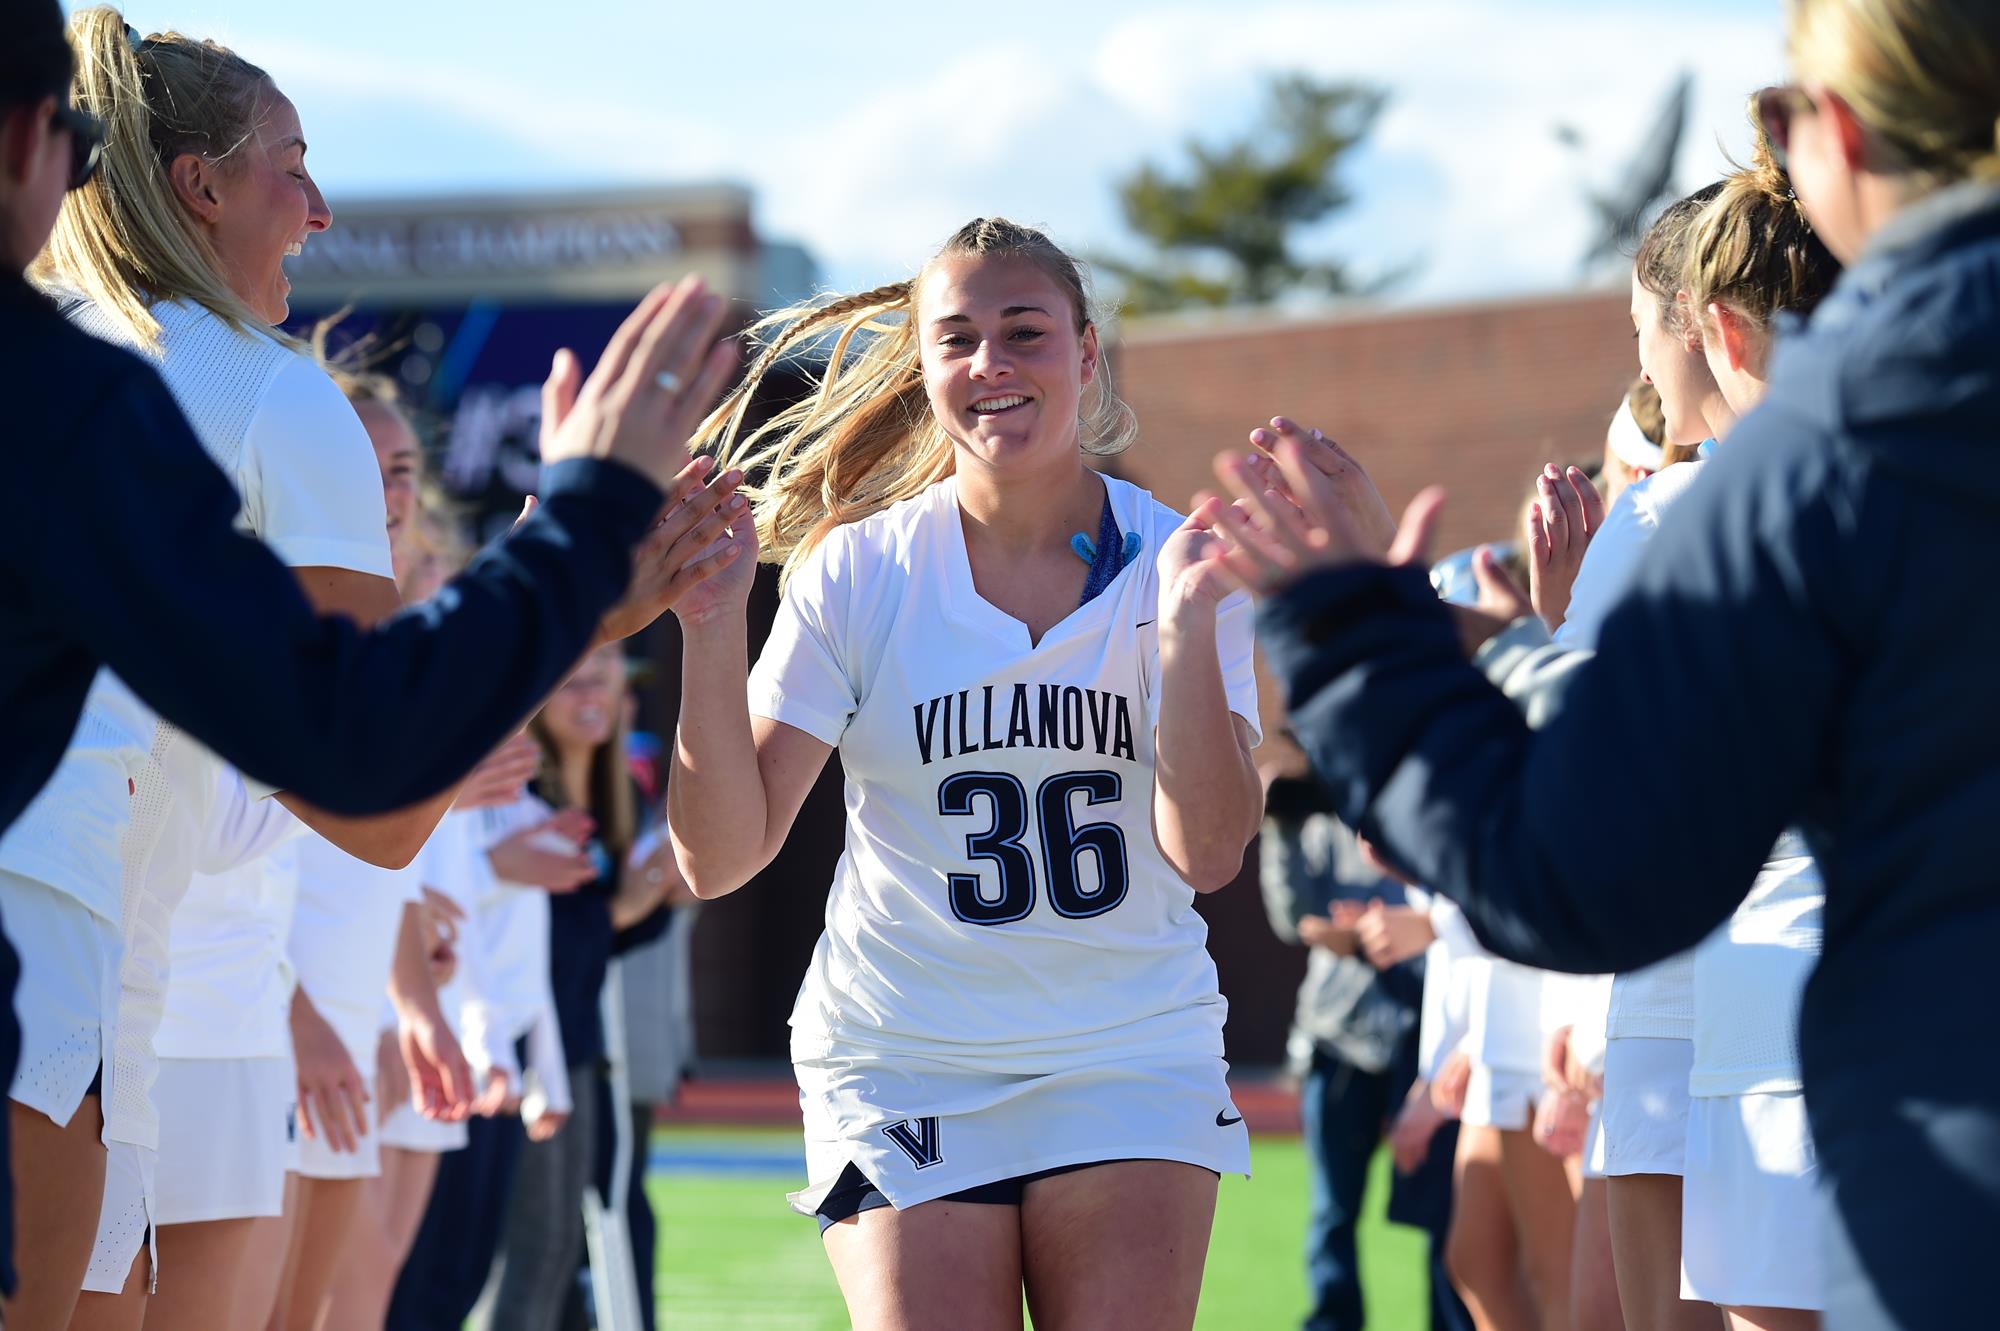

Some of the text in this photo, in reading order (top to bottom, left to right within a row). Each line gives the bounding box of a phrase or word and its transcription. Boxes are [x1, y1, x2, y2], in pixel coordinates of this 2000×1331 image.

[913, 683, 1136, 765] VILLANOVA
[938, 770, 1129, 926] 36
[882, 1116, 943, 1170] V
